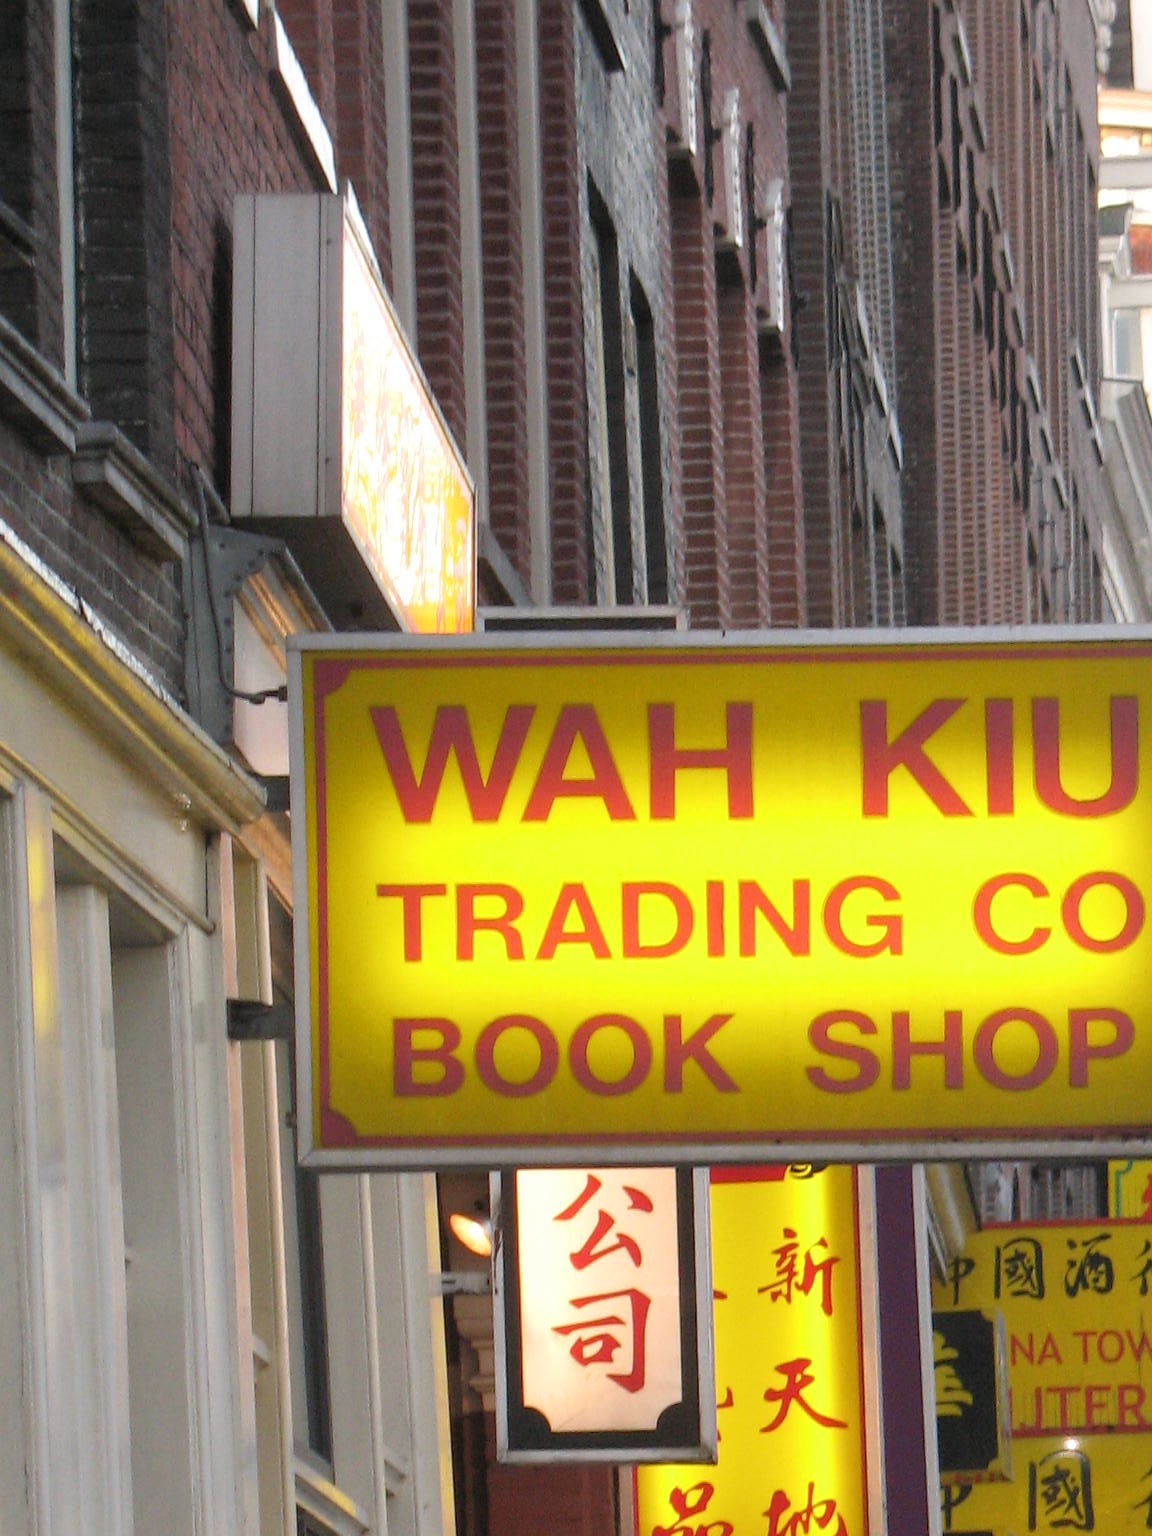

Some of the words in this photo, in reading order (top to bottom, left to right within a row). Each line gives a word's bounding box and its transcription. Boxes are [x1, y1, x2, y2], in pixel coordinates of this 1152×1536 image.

[369, 701, 755, 825] WAH
[859, 695, 1140, 819] KIU
[377, 876, 904, 963] TRADING
[972, 871, 1146, 956] CO
[392, 1013, 739, 1098] BOOK
[804, 1007, 1135, 1095] SHOP
[552, 1174, 653, 1394] 公司
